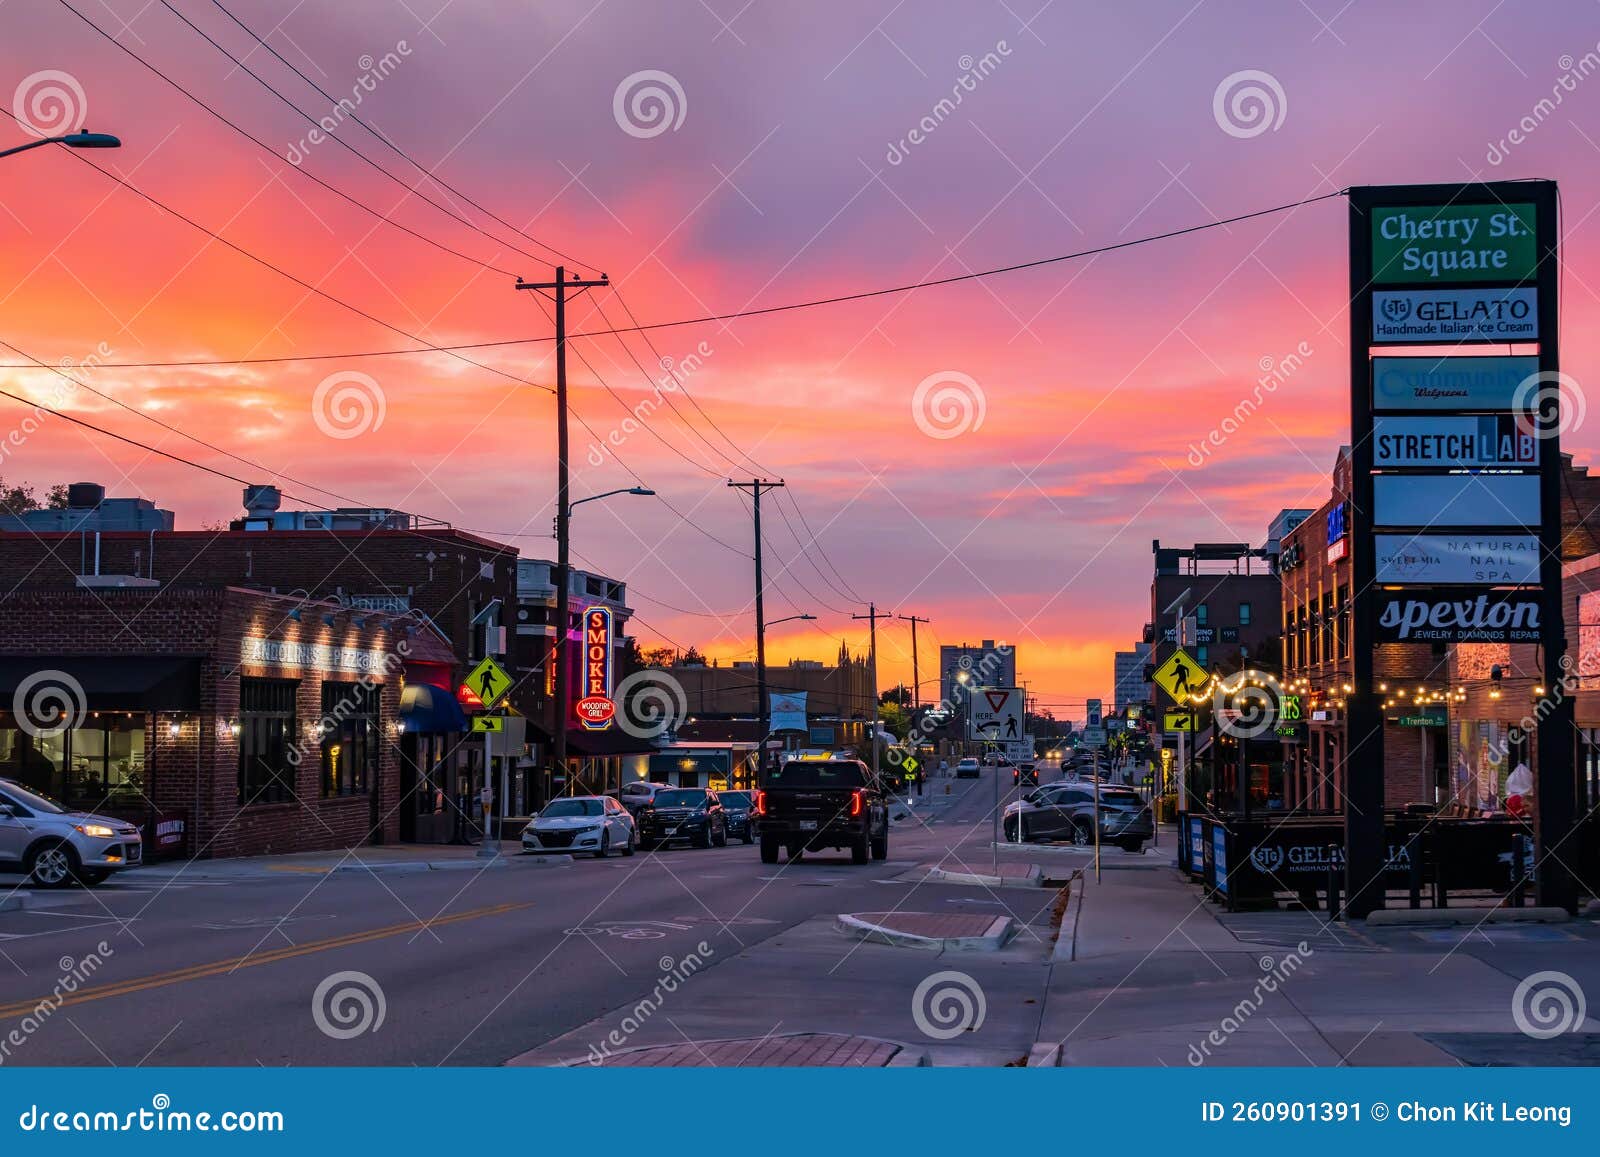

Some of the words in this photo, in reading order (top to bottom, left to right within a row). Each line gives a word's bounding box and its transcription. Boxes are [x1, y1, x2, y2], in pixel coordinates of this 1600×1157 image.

[1380, 213, 1479, 245] Cherry
[1489, 212, 1527, 237] St.
[1402, 247, 1508, 277] Square
[1416, 299, 1529, 321] GELATO
[1376, 323, 1437, 335] Handmade
[1440, 321, 1474, 334] Italian
[1497, 321, 1533, 333] Cream
[1447, 541, 1538, 551] NATURAL
[1470, 555, 1516, 566] NAIL
[1475, 571, 1512, 581] SPA
[1379, 595, 1541, 639] spexton
[1413, 630, 1452, 640] JEWELRY
[1457, 630, 1505, 640] DIAMONDS
[1510, 630, 1540, 640] REPAIR
[581, 702, 611, 710] WOODFIRE
[588, 709, 603, 717] GRILL
[975, 712, 993, 720] HERE
[1406, 717, 1434, 726] Trenton
